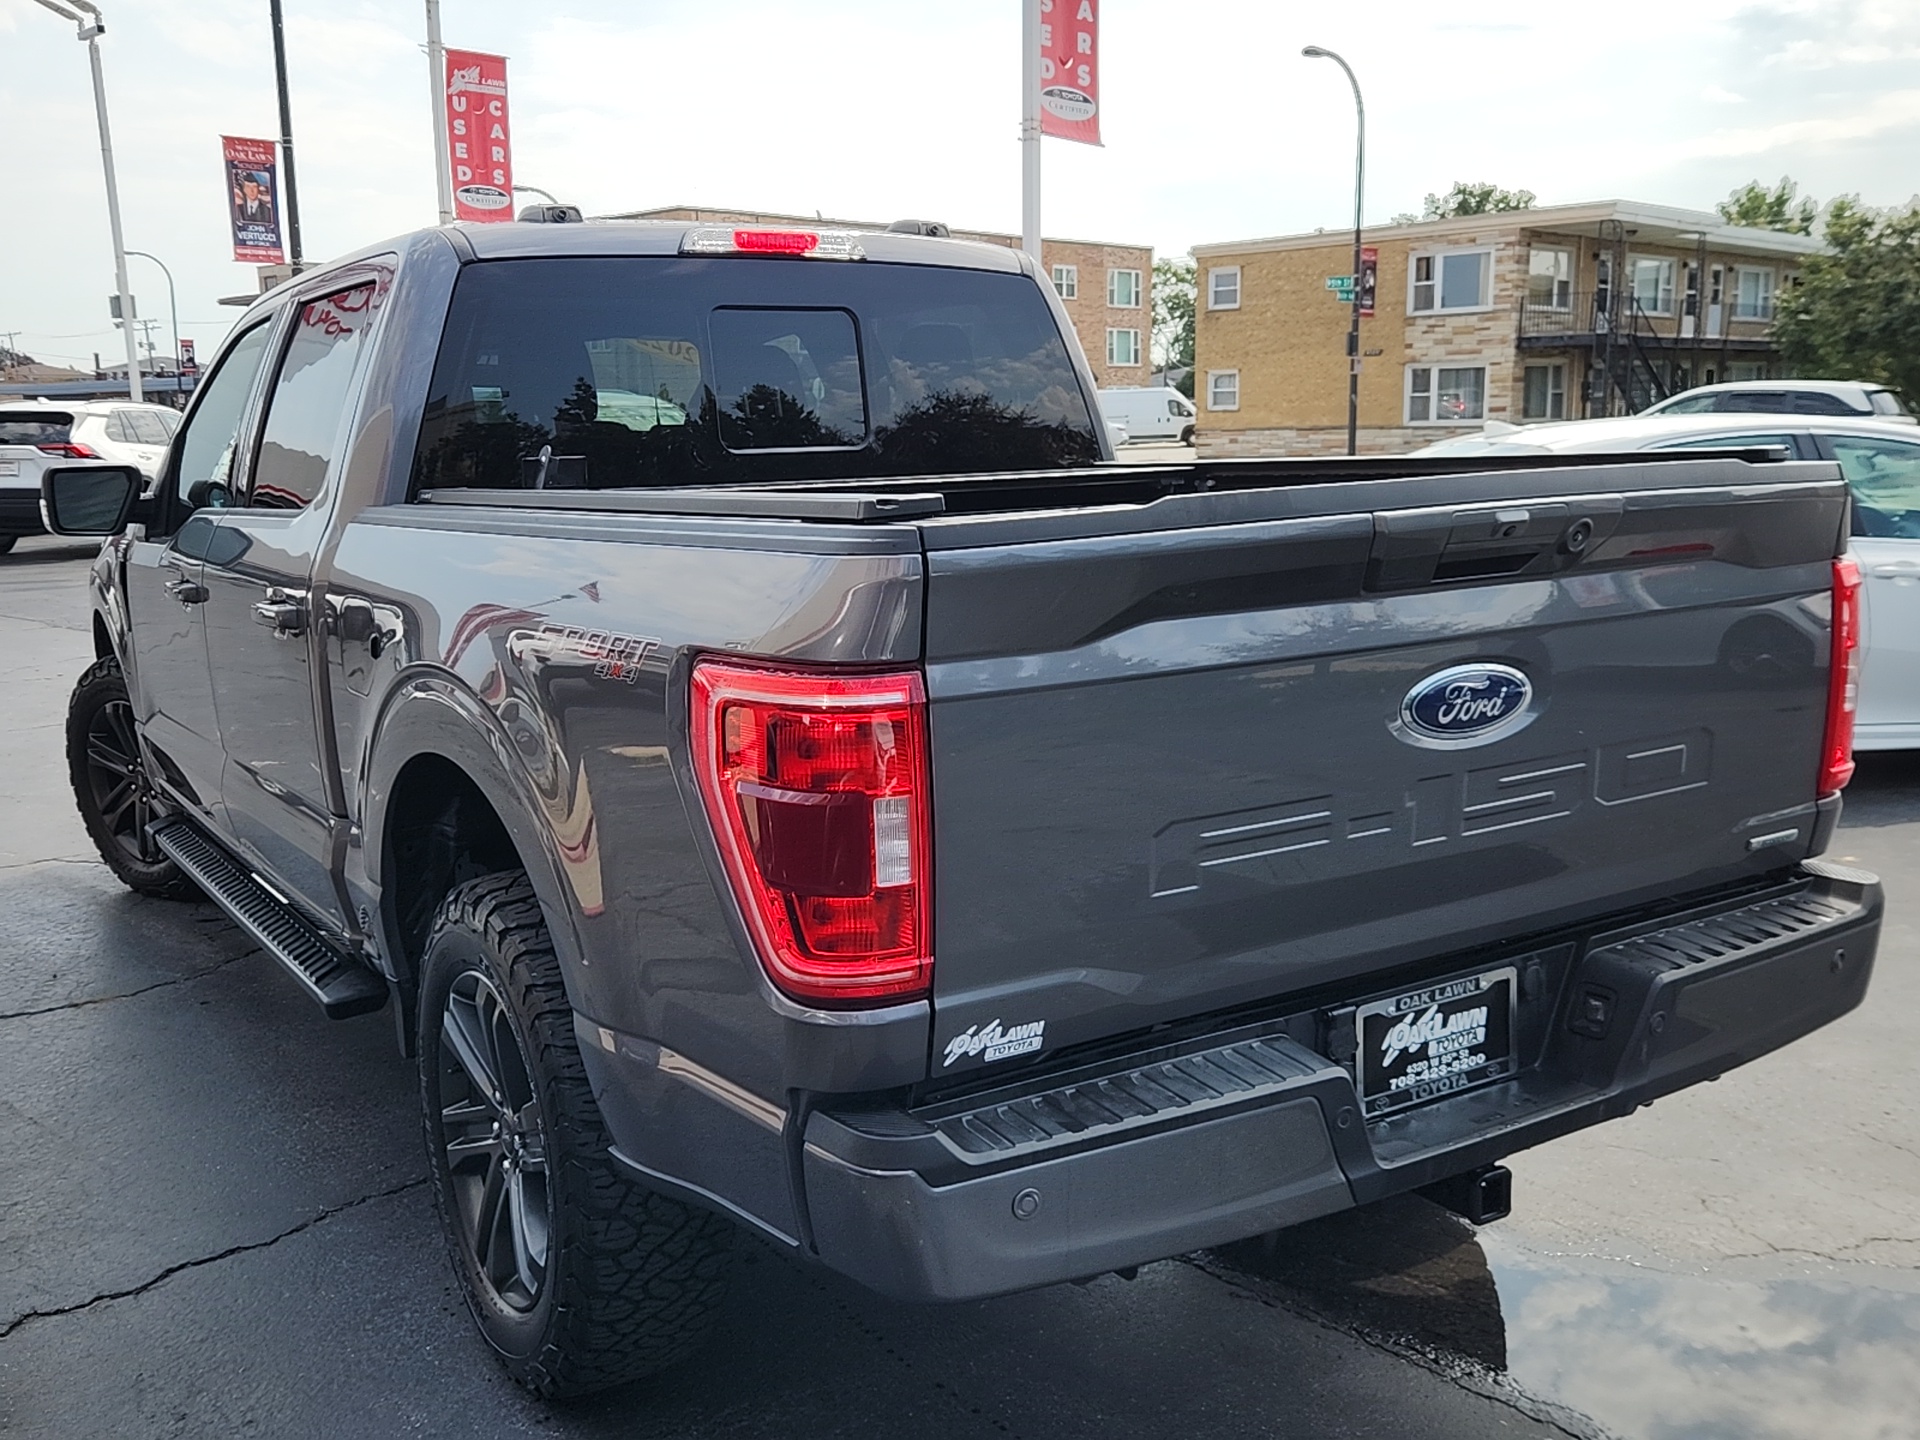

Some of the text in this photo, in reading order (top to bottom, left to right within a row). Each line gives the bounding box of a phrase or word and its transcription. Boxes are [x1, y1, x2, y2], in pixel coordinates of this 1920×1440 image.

[452, 96, 472, 182] USED
[489, 101, 505, 185] CARS
[236, 231, 277, 242] VERTUCCI
[1438, 679, 1508, 724] Ford
[1150, 727, 1712, 898] F-150
[1399, 980, 1476, 1010] OAK LAWN
[992, 1042, 1033, 1056] TOYOTA
[1437, 1030, 1478, 1052] TOYOTA
[1409, 1074, 1469, 1101] TOYOTA
